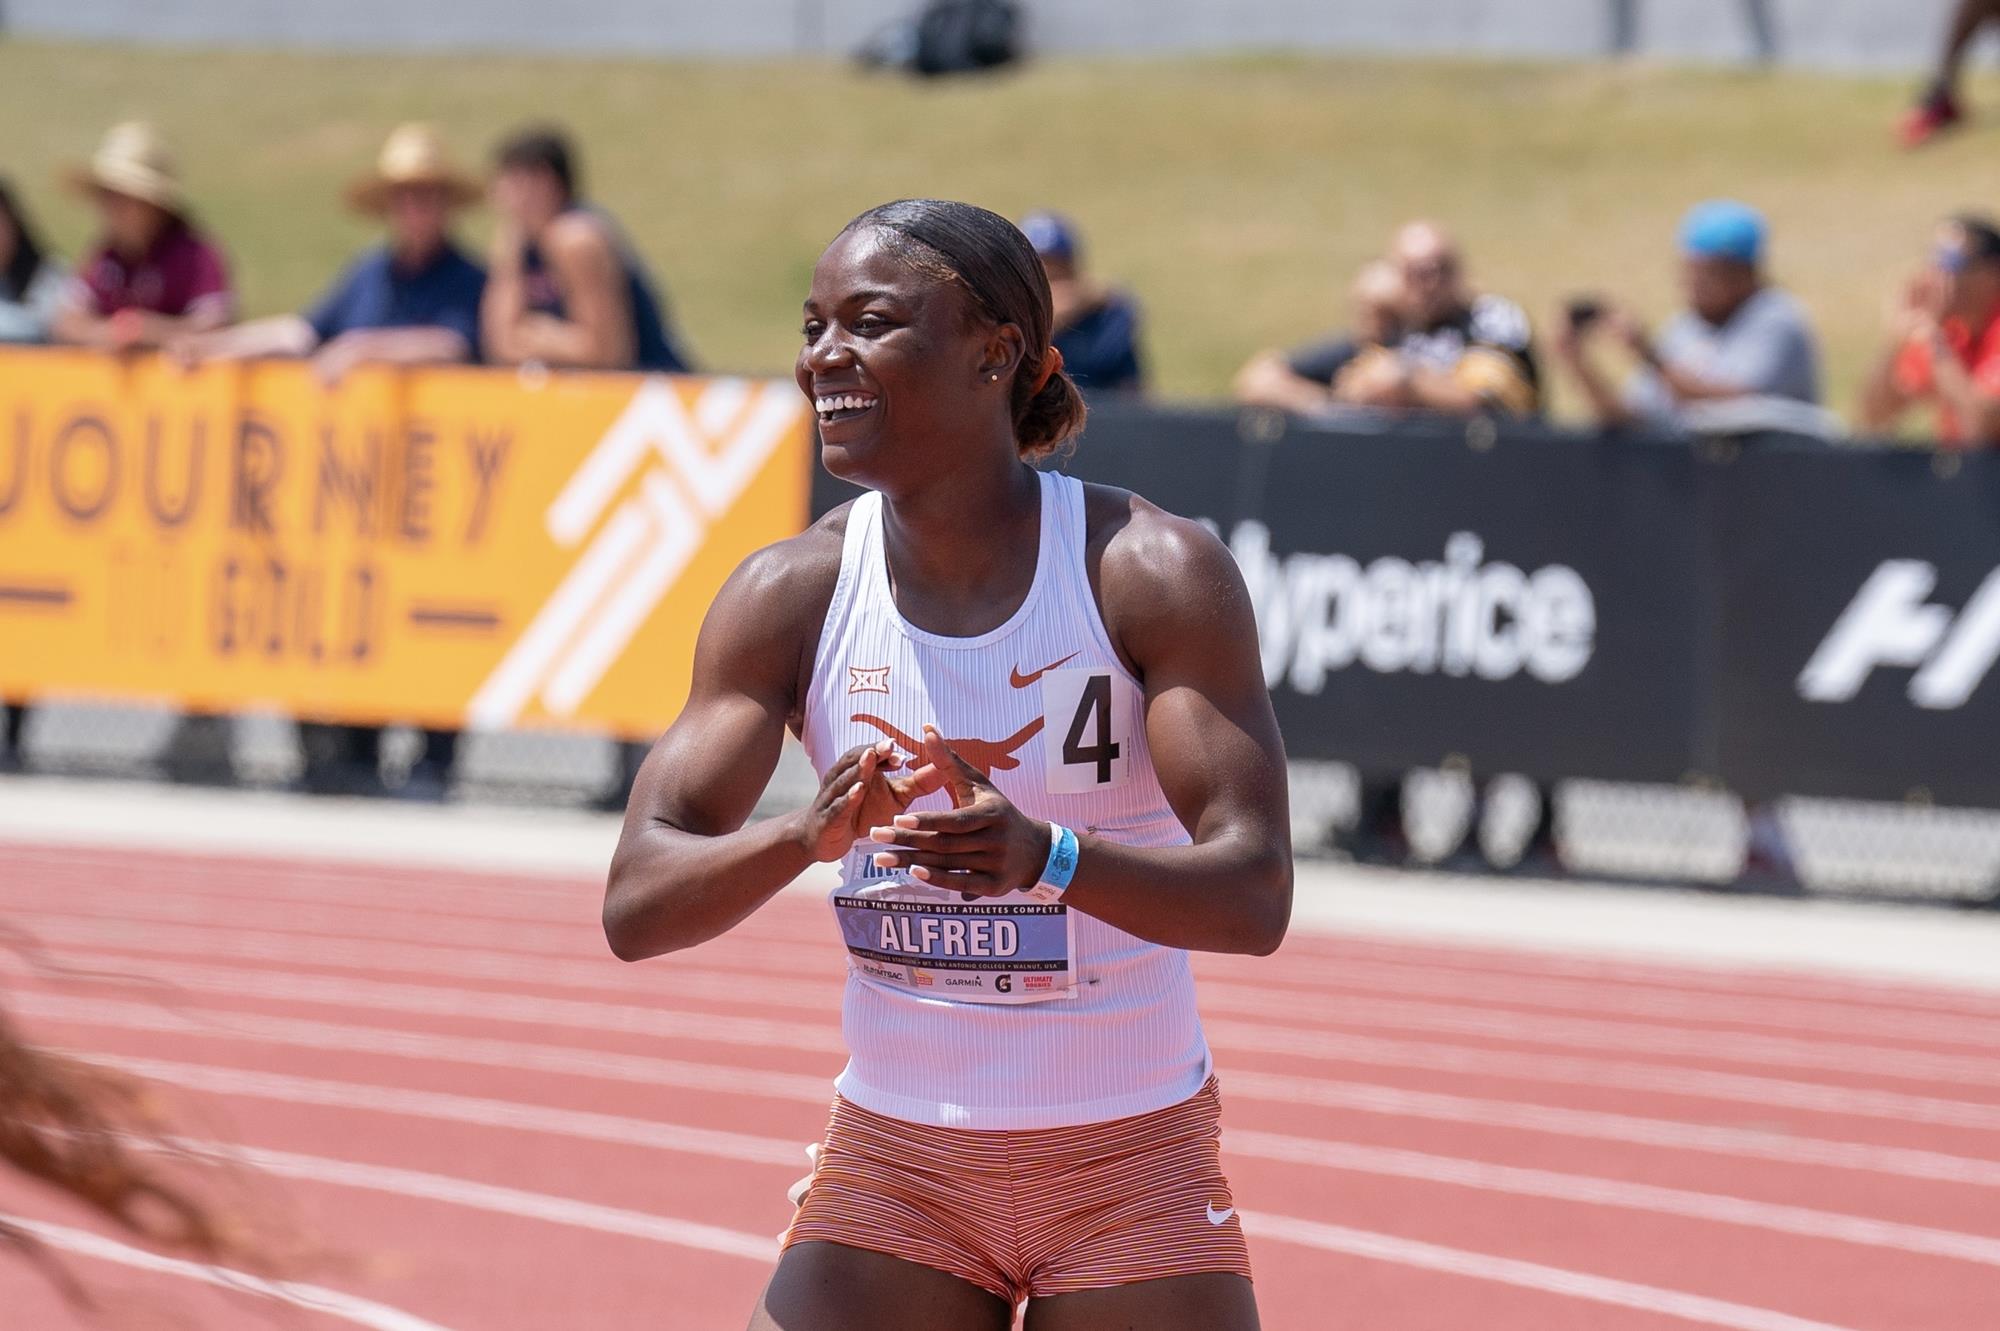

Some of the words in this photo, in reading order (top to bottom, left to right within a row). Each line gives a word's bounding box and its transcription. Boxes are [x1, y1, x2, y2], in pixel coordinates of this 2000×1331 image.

[0, 410, 512, 543] JOURNEY
[1062, 674, 1120, 784] 4
[838, 898, 868, 909] WHERE
[892, 903, 931, 912] WORLD'S
[935, 905, 958, 913] BEST
[962, 906, 1009, 914] ATHLETES
[1013, 906, 1059, 914] COMPETE
[880, 914, 1019, 958] ALFRED
[978, 962, 1006, 970] COLLEGE
[1013, 963, 1043, 971] WALNUT,
[945, 977, 982, 987] GARMIN
[995, 974, 1012, 993] G
